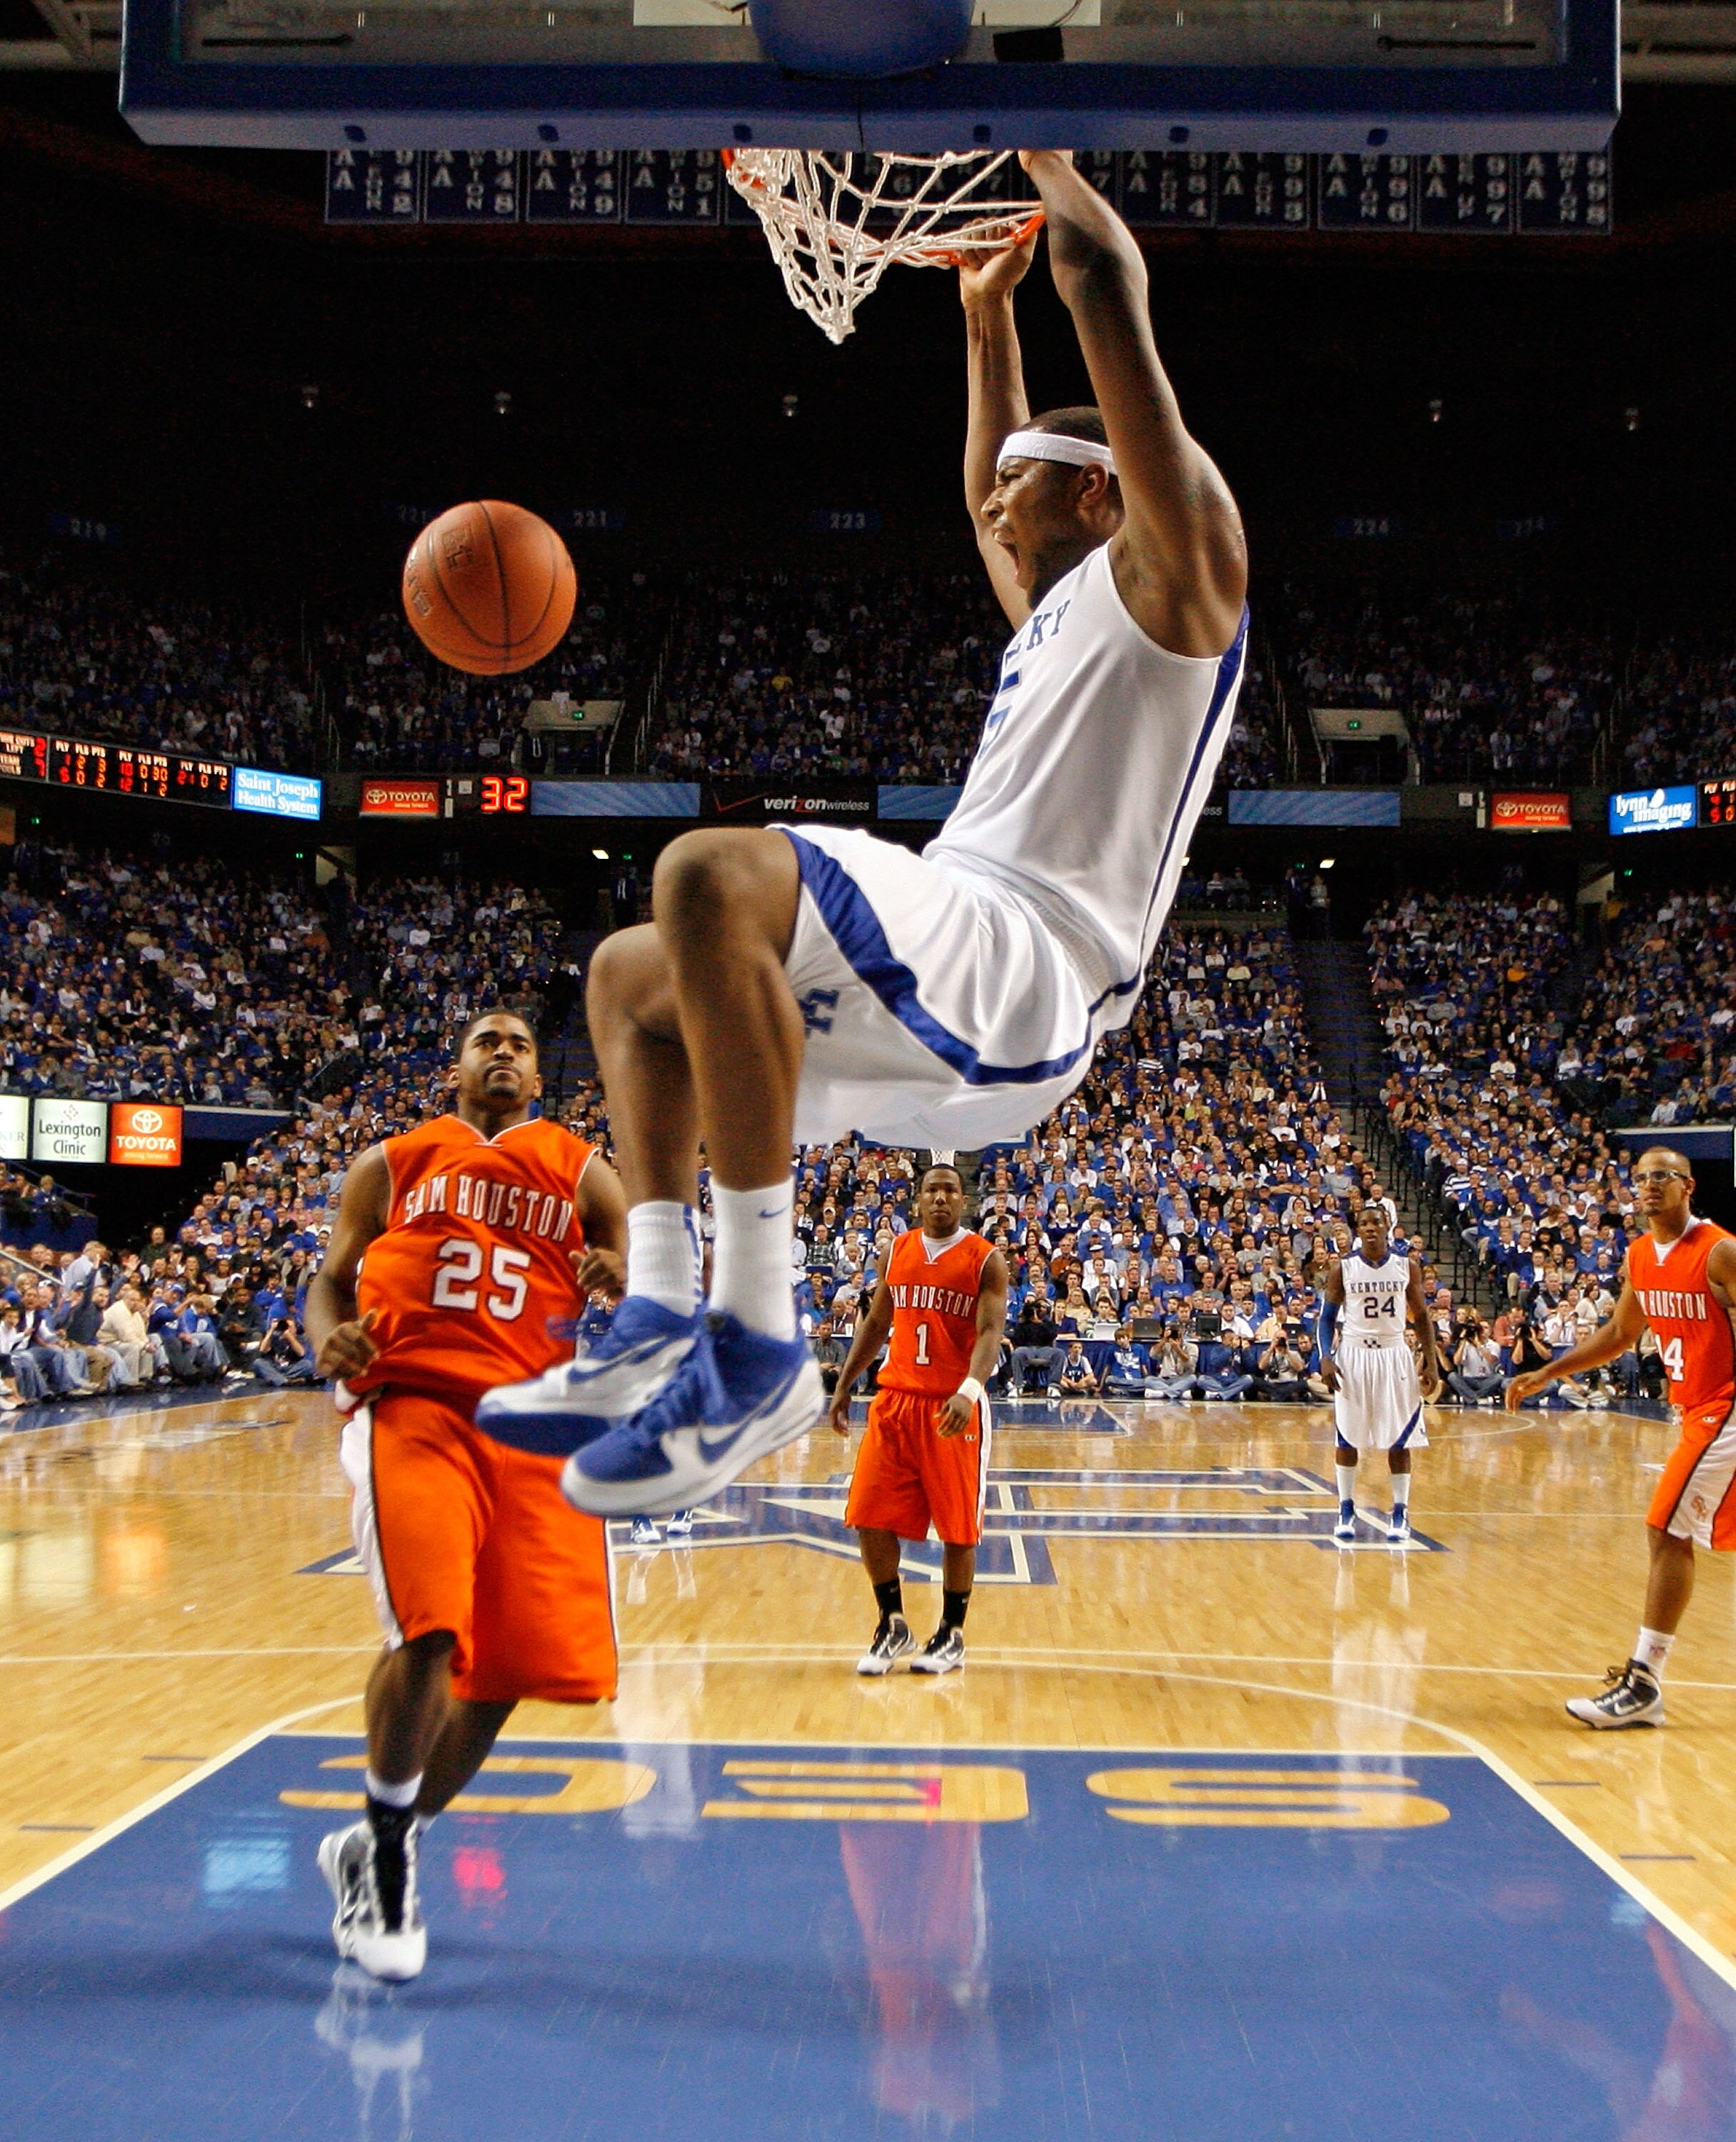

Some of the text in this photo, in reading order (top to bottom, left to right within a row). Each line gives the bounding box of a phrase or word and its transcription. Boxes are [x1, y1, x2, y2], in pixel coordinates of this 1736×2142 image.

[594, 150, 614, 213] 949
[696, 150, 715, 216] 951
[238, 773, 318, 801] Saint Joseph
[388, 792, 435, 802] TOYOTA
[481, 776, 528, 812] 32
[239, 790, 318, 814] Health System
[1517, 803, 1565, 815] TOYOTA
[1616, 795, 1648, 817] lynn
[1633, 803, 1692, 824] imaging
[39, 1119, 101, 1139] Lexington
[53, 1140, 86, 1155] Clinic
[116, 1135, 176, 1151] TOYOTA
[404, 1174, 572, 1242] SAM HOUSTON
[431, 1237, 531, 1321] 25
[1350, 1280, 1405, 1294] KENTUCKY
[912, 1284, 974, 1317] HOUSTON
[1363, 1296, 1396, 1319] 24
[915, 1323, 930, 1365] 1
